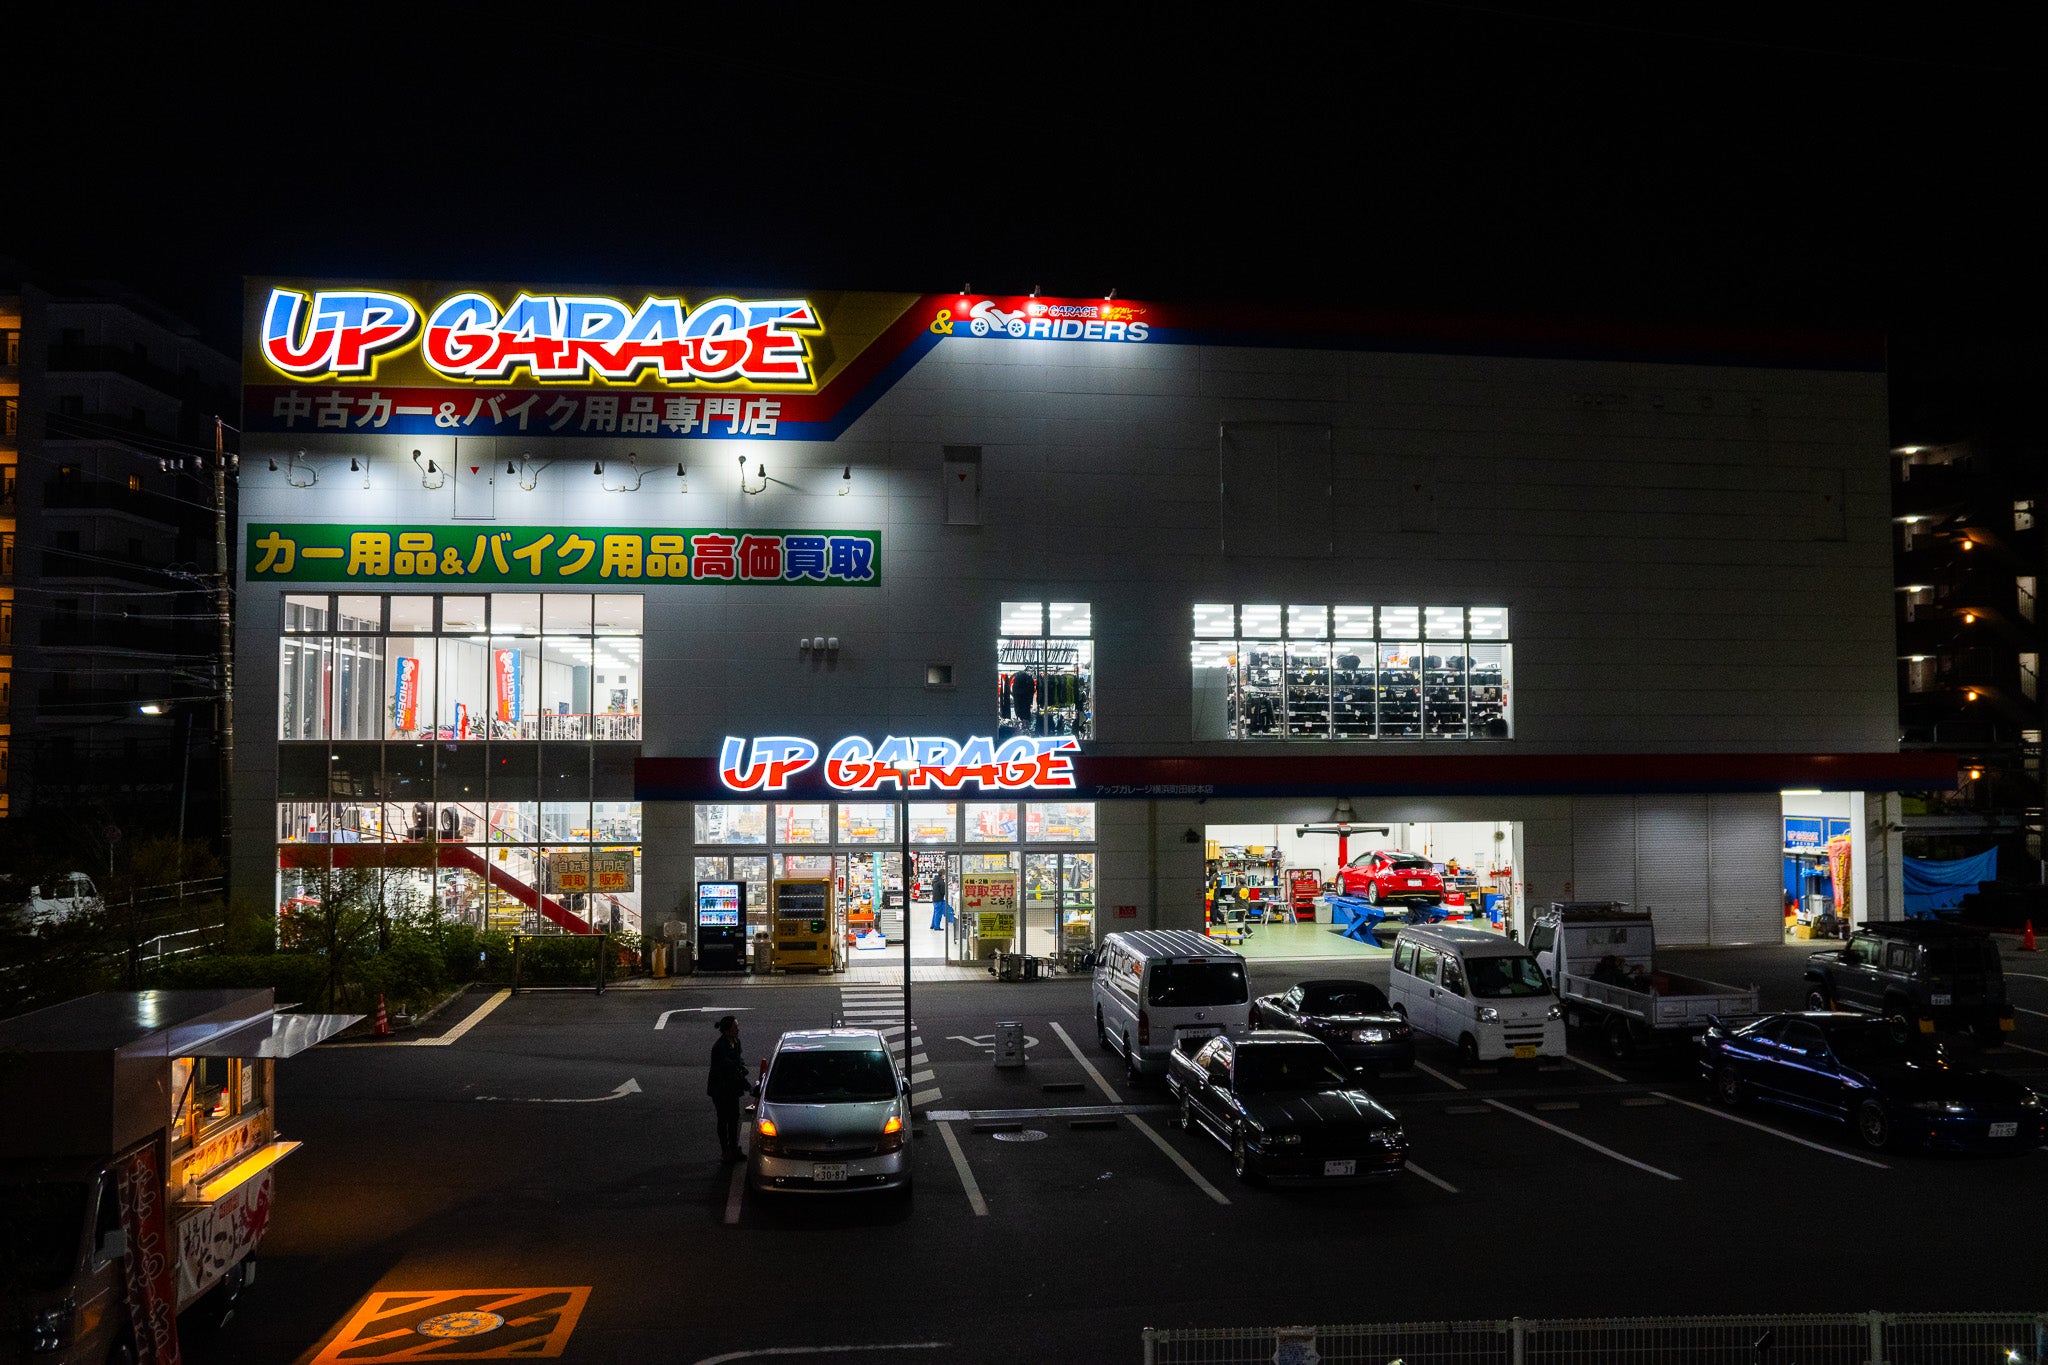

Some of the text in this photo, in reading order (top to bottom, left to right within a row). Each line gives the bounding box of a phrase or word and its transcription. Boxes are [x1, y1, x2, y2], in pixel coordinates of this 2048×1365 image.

[1028, 317, 1150, 342] RIDERS
[1049, 305, 1098, 319] GARAGE
[260, 288, 818, 384] UP GARAGE
[272, 390, 782, 437] 中古カー&バイク用品専門店
[254, 530, 875, 582] カー用品&バイク用品高価買取
[719, 735, 1082, 793] UP GARAGE
[558, 860, 625, 873] 自転車専門店
[965, 885, 1014, 898] 買取受付
